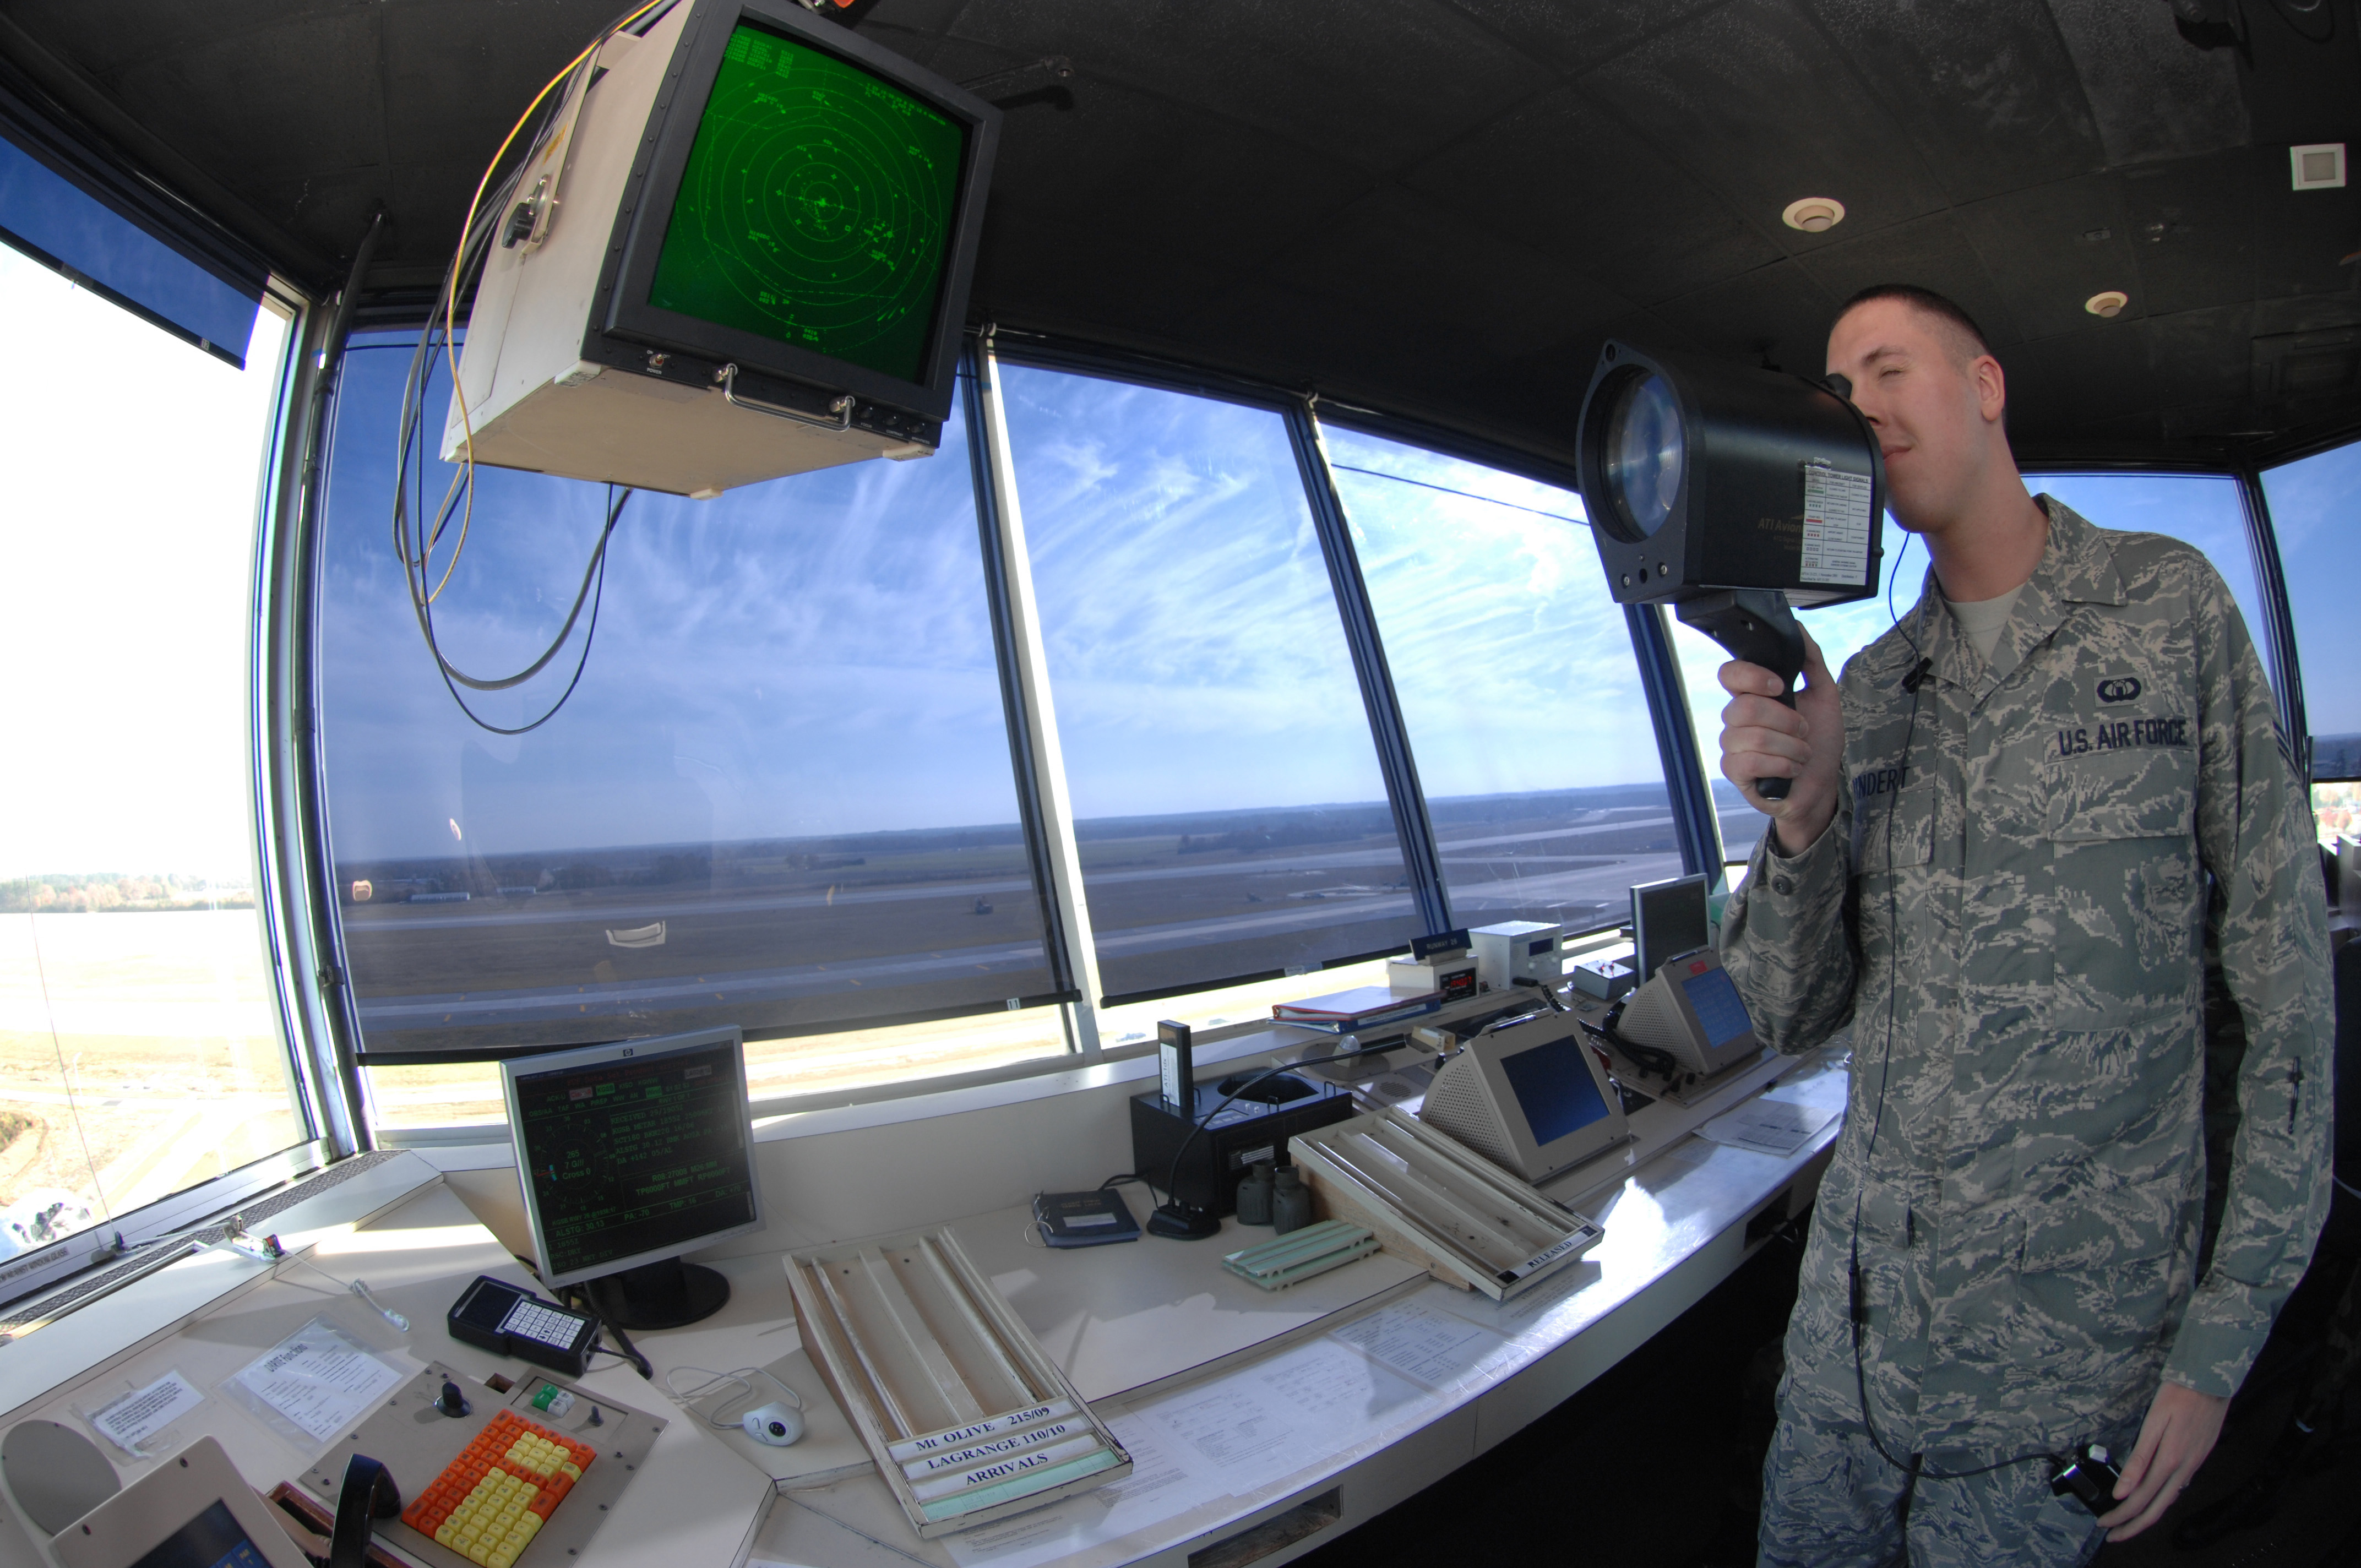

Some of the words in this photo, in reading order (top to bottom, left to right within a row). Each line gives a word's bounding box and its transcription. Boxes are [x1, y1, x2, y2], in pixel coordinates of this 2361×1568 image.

[1758, 518, 1774, 530] ATI
[2059, 729, 2093, 756] U.S.
[2097, 722, 2131, 749] AIR
[2134, 718, 2187, 747] FORCE
[1427, 940, 1448, 950] RUNWAY
[547, 1093, 566, 1102] ACK-U
[529, 1108, 553, 1117] OBS/AA
[590, 1098, 608, 1106] PIREP
[611, 1112, 646, 1125] RECEIVED
[612, 1125, 630, 1135] KGSB
[634, 1120, 656, 1131] METAR
[567, 1150, 580, 1158] 265
[616, 1144, 638, 1155] ALSTG
[642, 1140, 663, 1148] 30.12
[630, 1154, 648, 1162] +142
[562, 1170, 584, 1179] Cross
[635, 1182, 670, 1196] TP6000FT
[715, 1189, 727, 1198] DA:
[669, 1200, 686, 1210] TMP:
[624, 1212, 637, 1221] PA:
[556, 1226, 584, 1238] ALSTG:
[585, 1220, 605, 1229] 30.13
[50, 1249, 68, 1261] GLASS
[1527, 1240, 1573, 1268] RELEASED
[915, 1437, 938, 1452] Mt
[943, 1421, 995, 1444] OLIVE
[1007, 1406, 1051, 1426] 215/09
[927, 1437, 1021, 1470] LAGRANGE
[1021, 1423, 1066, 1446] 110/10
[966, 1452, 1049, 1485] ARRIVALS
